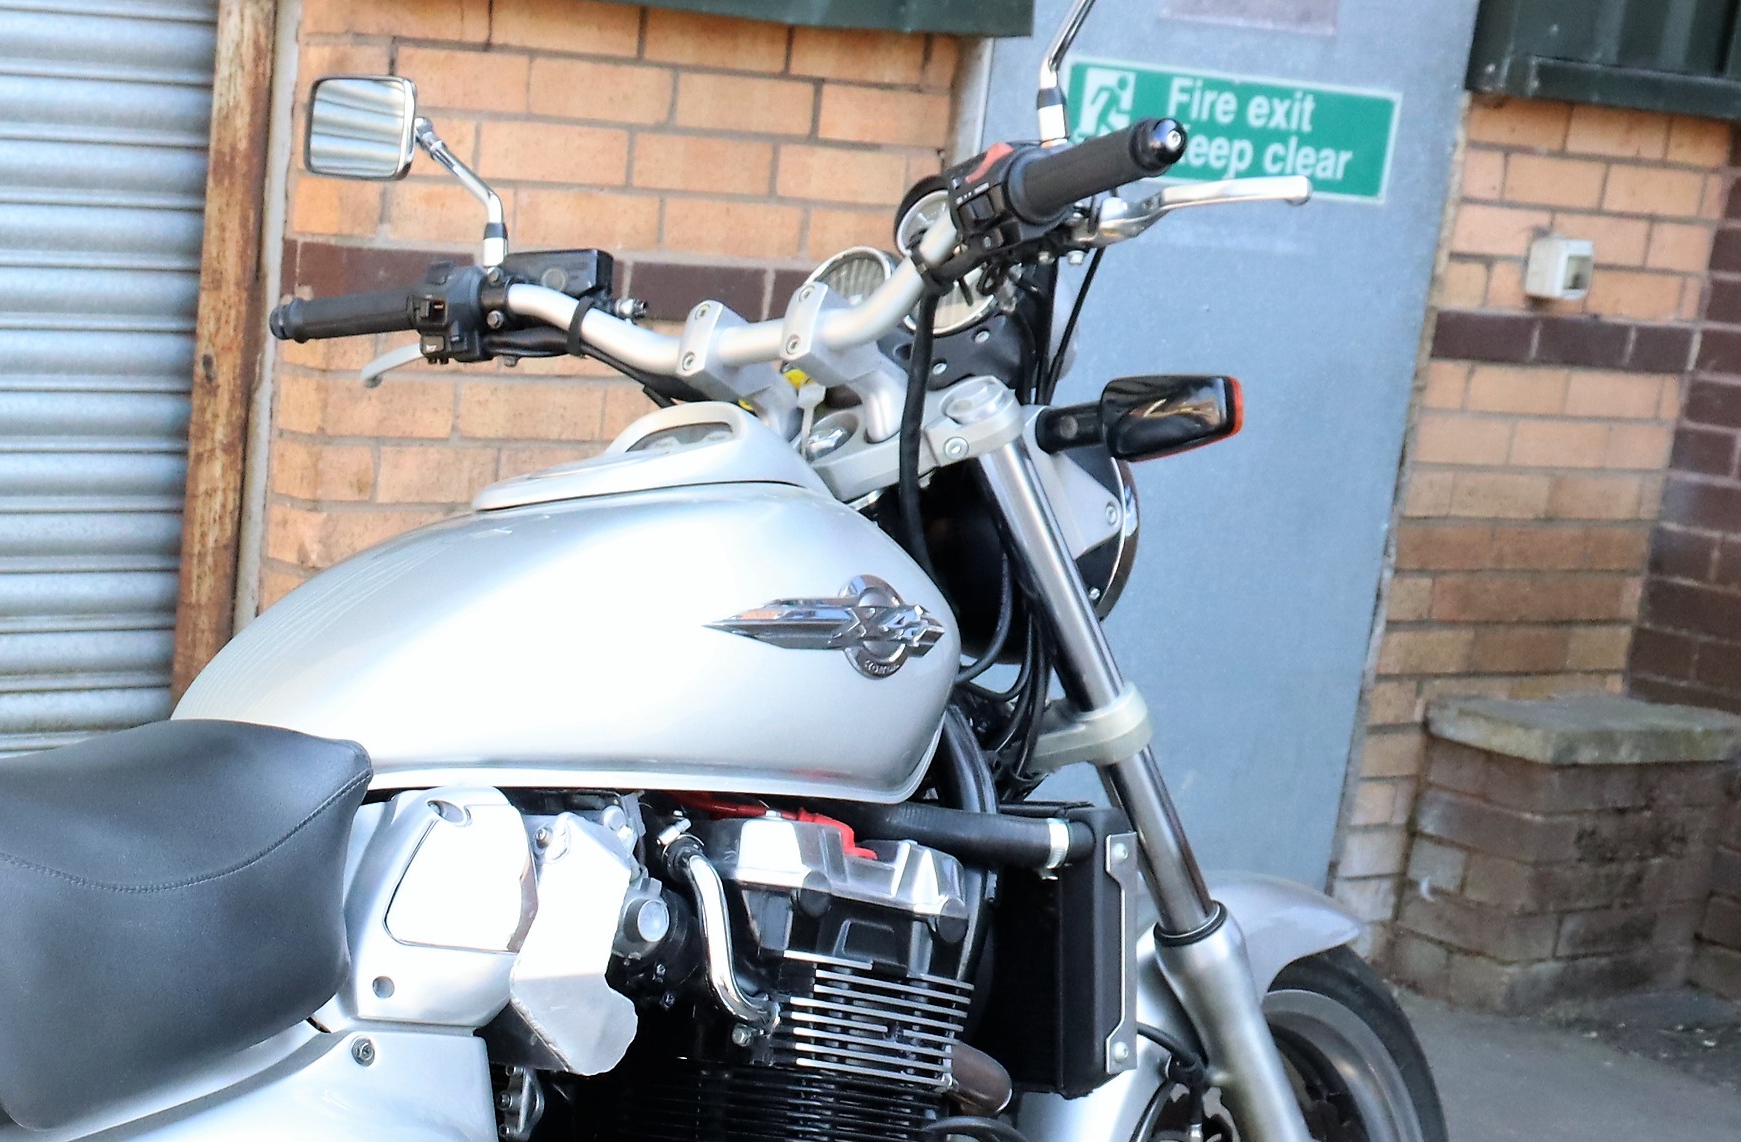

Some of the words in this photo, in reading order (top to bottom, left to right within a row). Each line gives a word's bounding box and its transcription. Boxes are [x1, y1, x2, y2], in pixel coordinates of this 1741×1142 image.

[1167, 76, 1238, 125] Fire
[1246, 90, 1316, 133] exit
[1176, 125, 1254, 180] eep
[1263, 136, 1353, 181] clear
